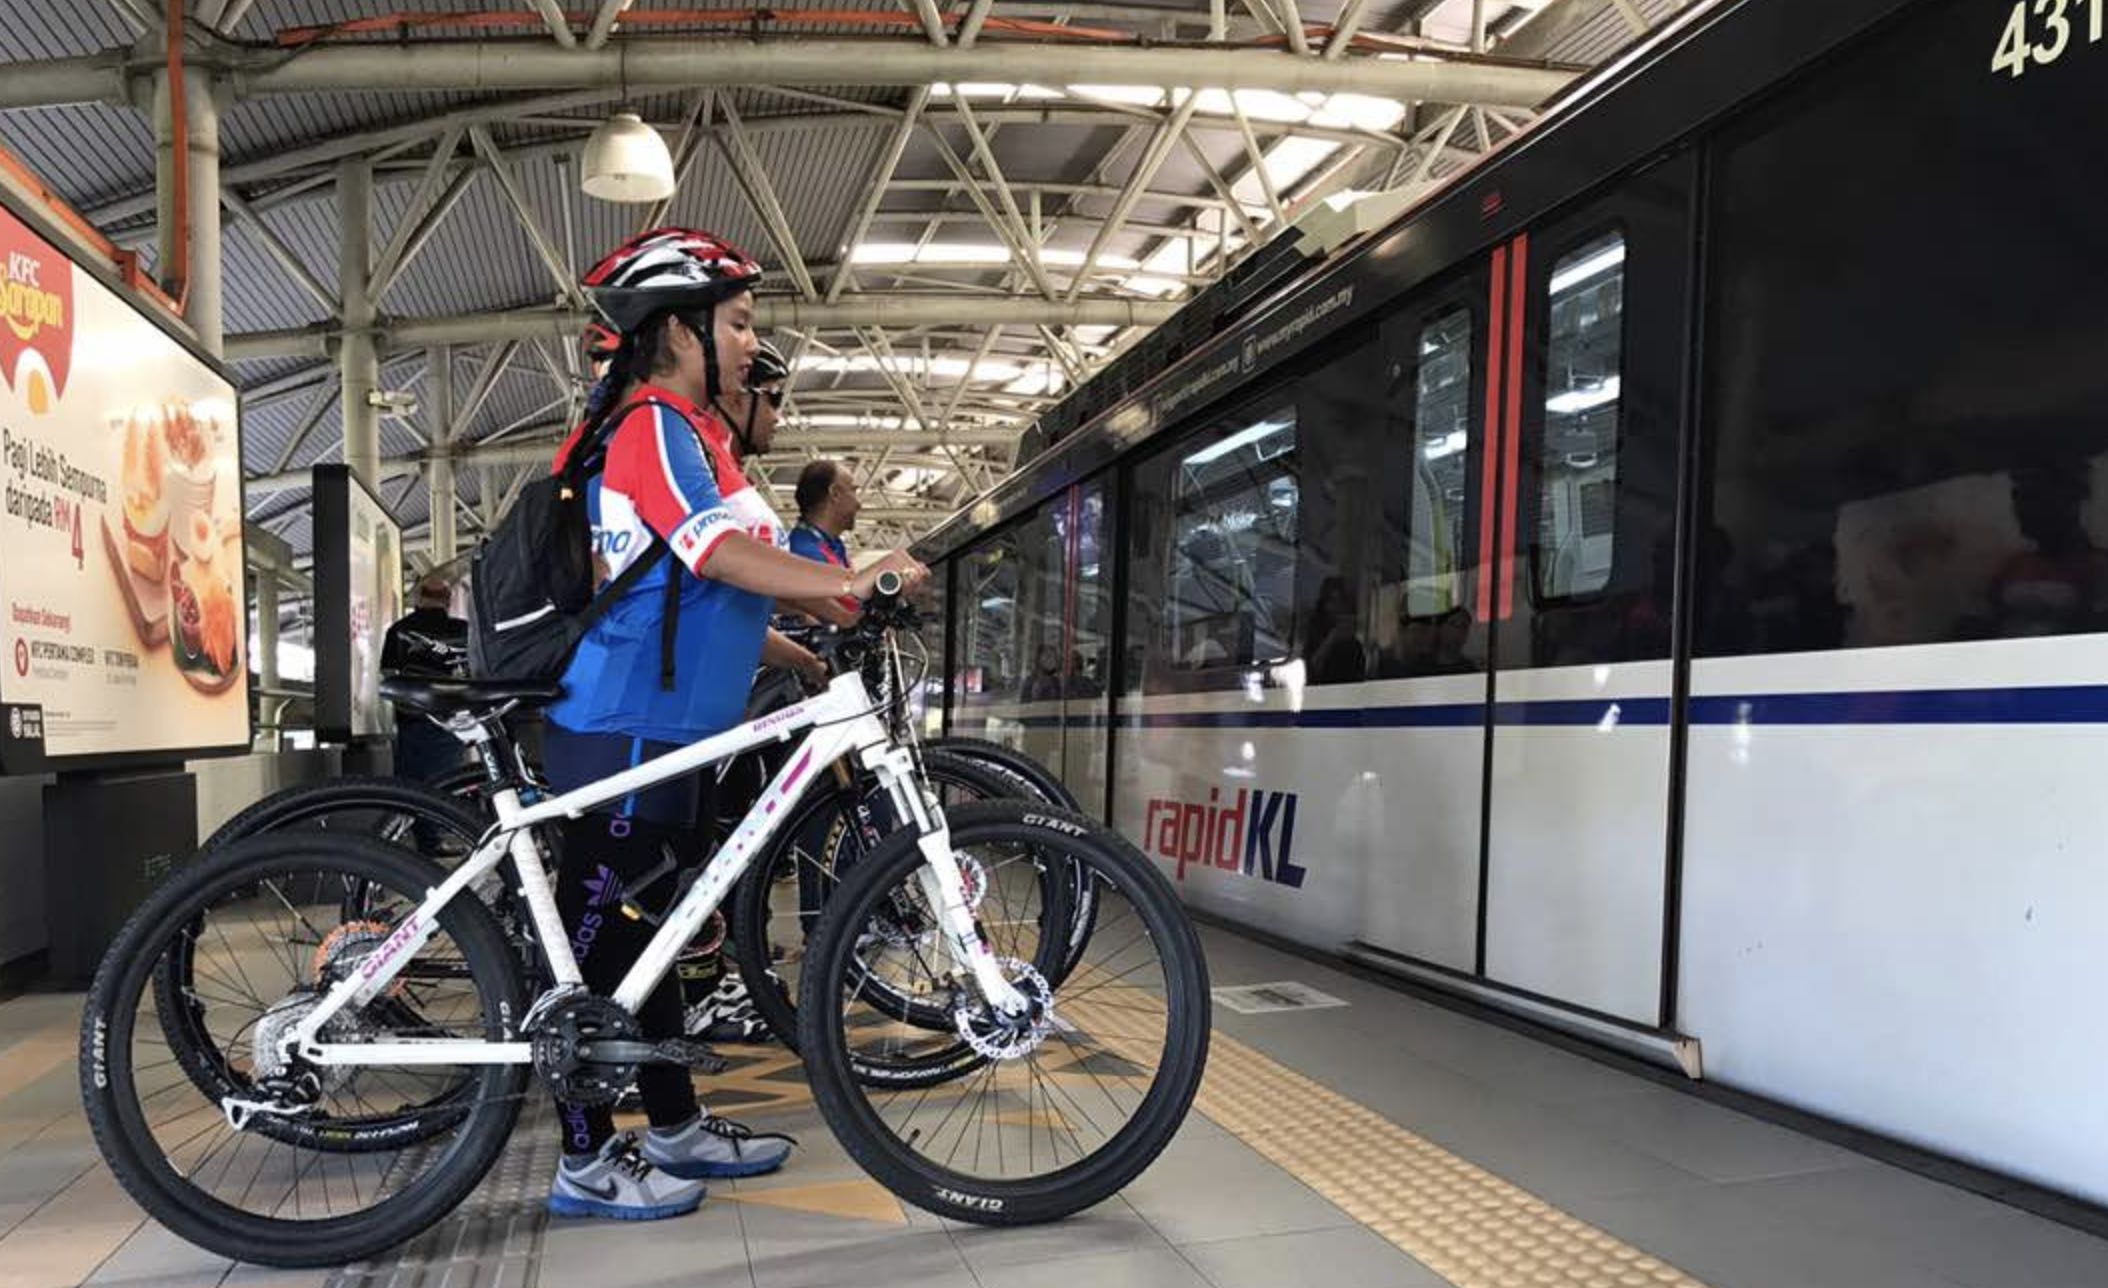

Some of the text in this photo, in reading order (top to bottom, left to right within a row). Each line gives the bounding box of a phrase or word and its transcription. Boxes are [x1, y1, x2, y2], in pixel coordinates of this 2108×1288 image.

[8, 251, 41, 286] KFC
[3, 428, 107, 504] Pagi Lebih Sempurna
[5, 479, 53, 529] daripada
[71, 503, 84, 570] 4
[1023, 814, 1089, 837] GIANT
[1144, 787, 1307, 889] rapidKL
[362, 914, 419, 980] GIANT
[93, 1016, 107, 1089] GIANT
[932, 1186, 1004, 1212] GIANT
